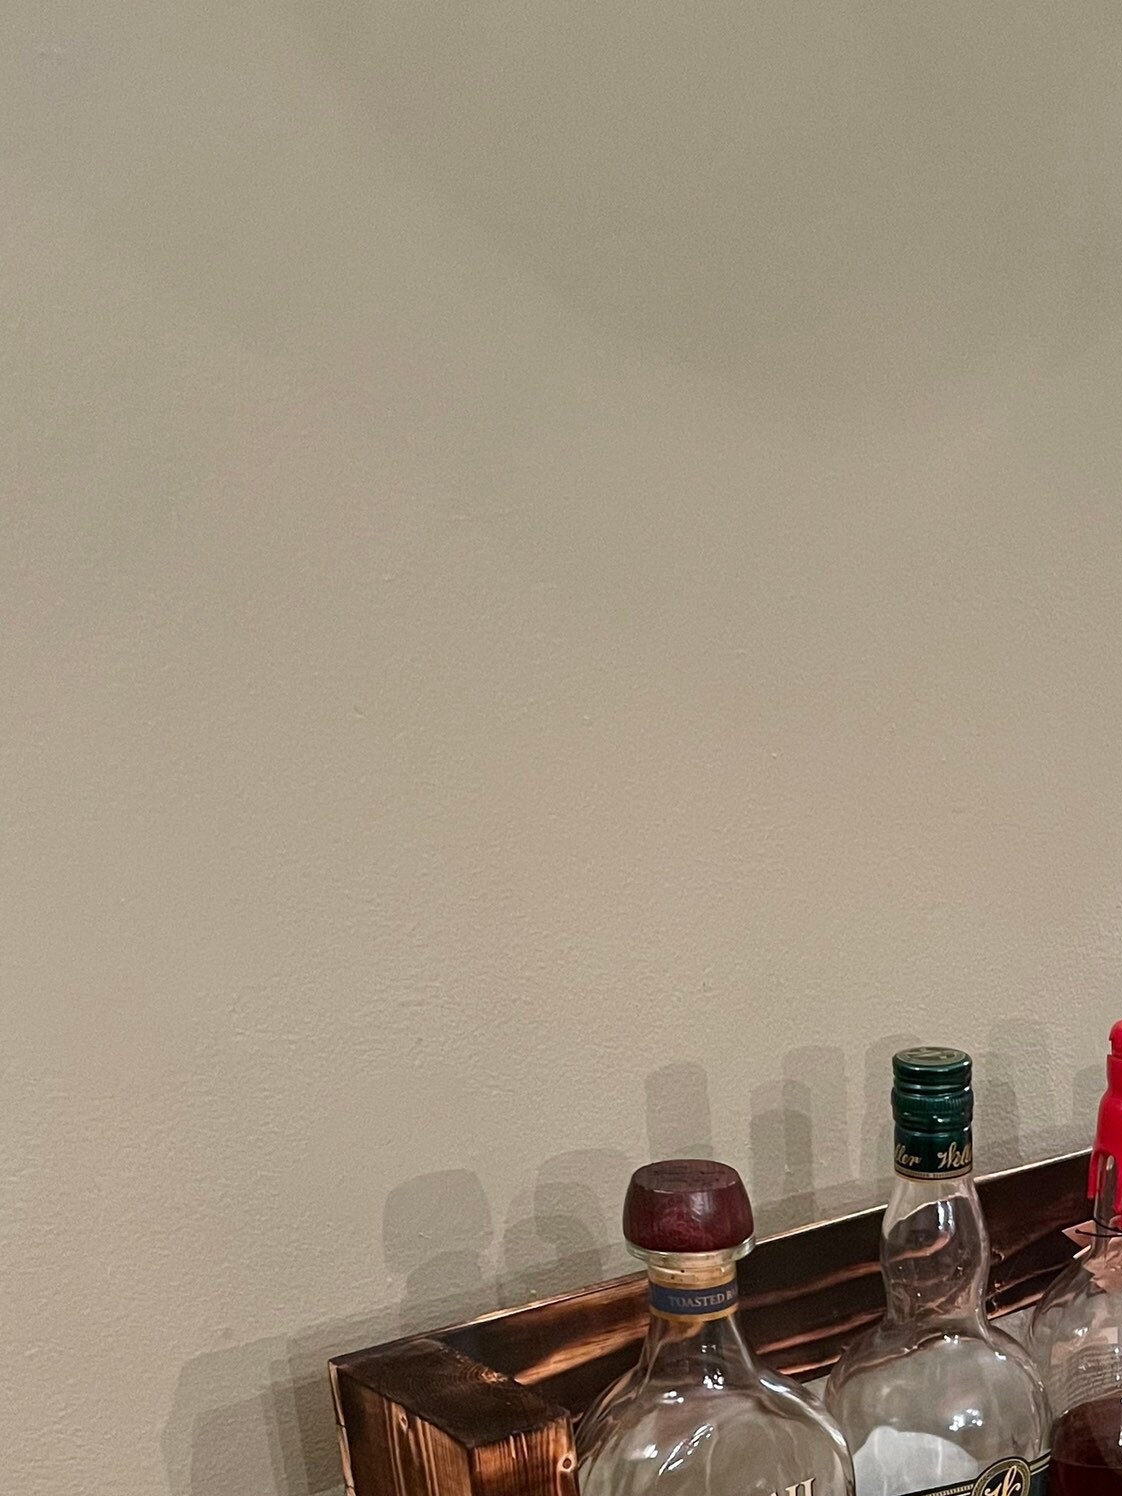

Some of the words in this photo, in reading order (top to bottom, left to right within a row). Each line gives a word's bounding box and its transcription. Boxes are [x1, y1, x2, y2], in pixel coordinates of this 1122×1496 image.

[895, 1143, 921, 1167] ller
[937, 1141, 972, 1169] Well
[668, 1293, 725, 1308] TOASTED
